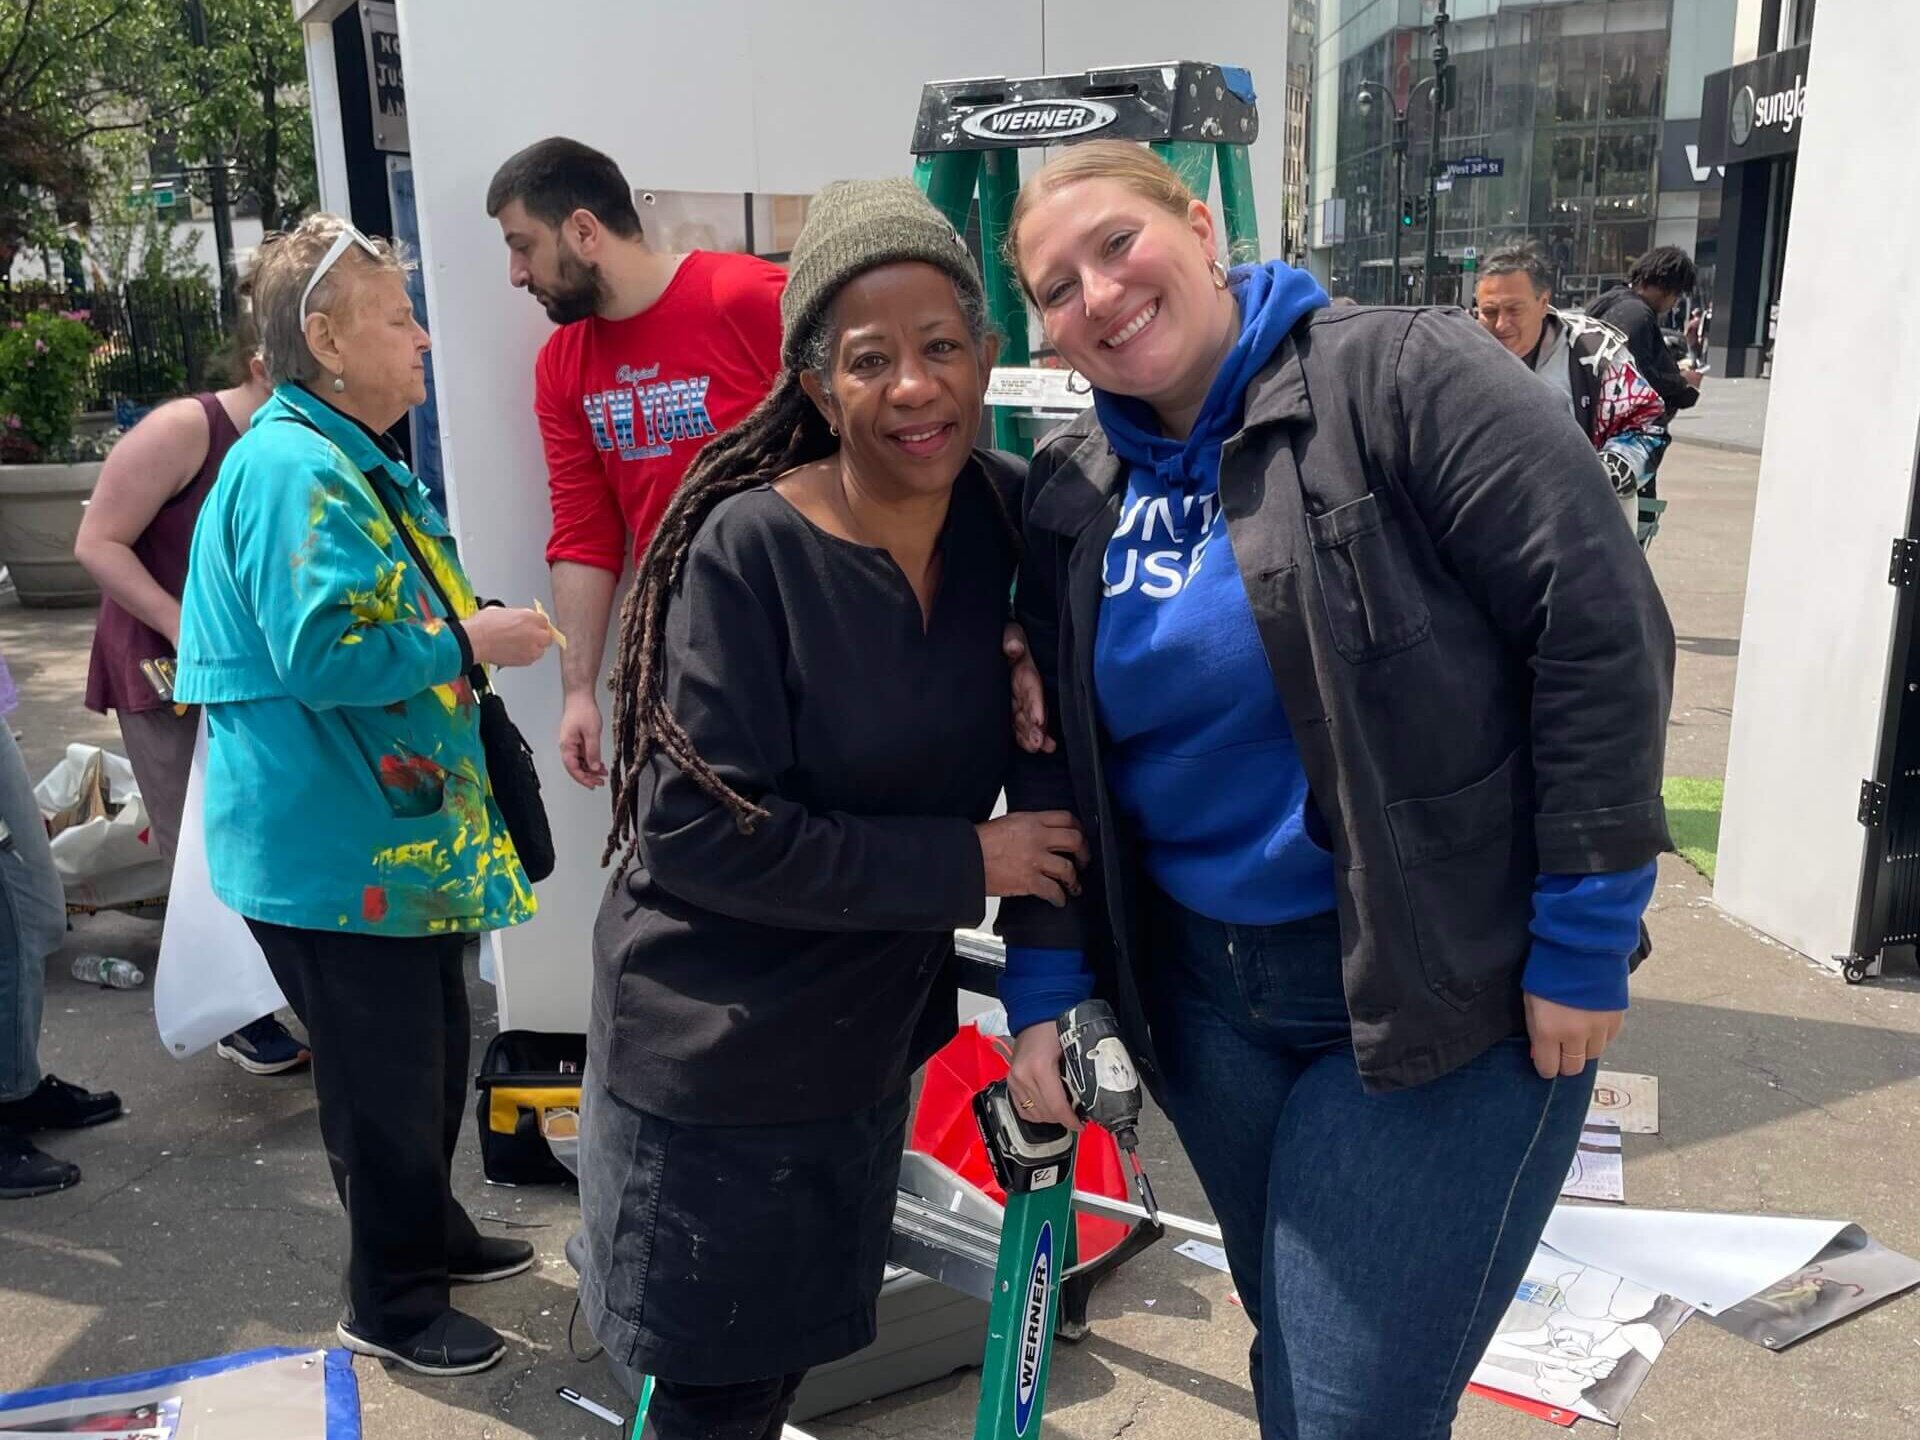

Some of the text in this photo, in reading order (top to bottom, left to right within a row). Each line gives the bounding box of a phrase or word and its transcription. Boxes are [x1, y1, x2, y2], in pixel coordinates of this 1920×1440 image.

[992, 108, 1086, 131] WERNER
[1755, 74, 1807, 133] sungla
[1447, 162, 1499, 175] West 34th St
[636, 376, 717, 445] YORK
[1021, 1265, 1047, 1388] WERNER
